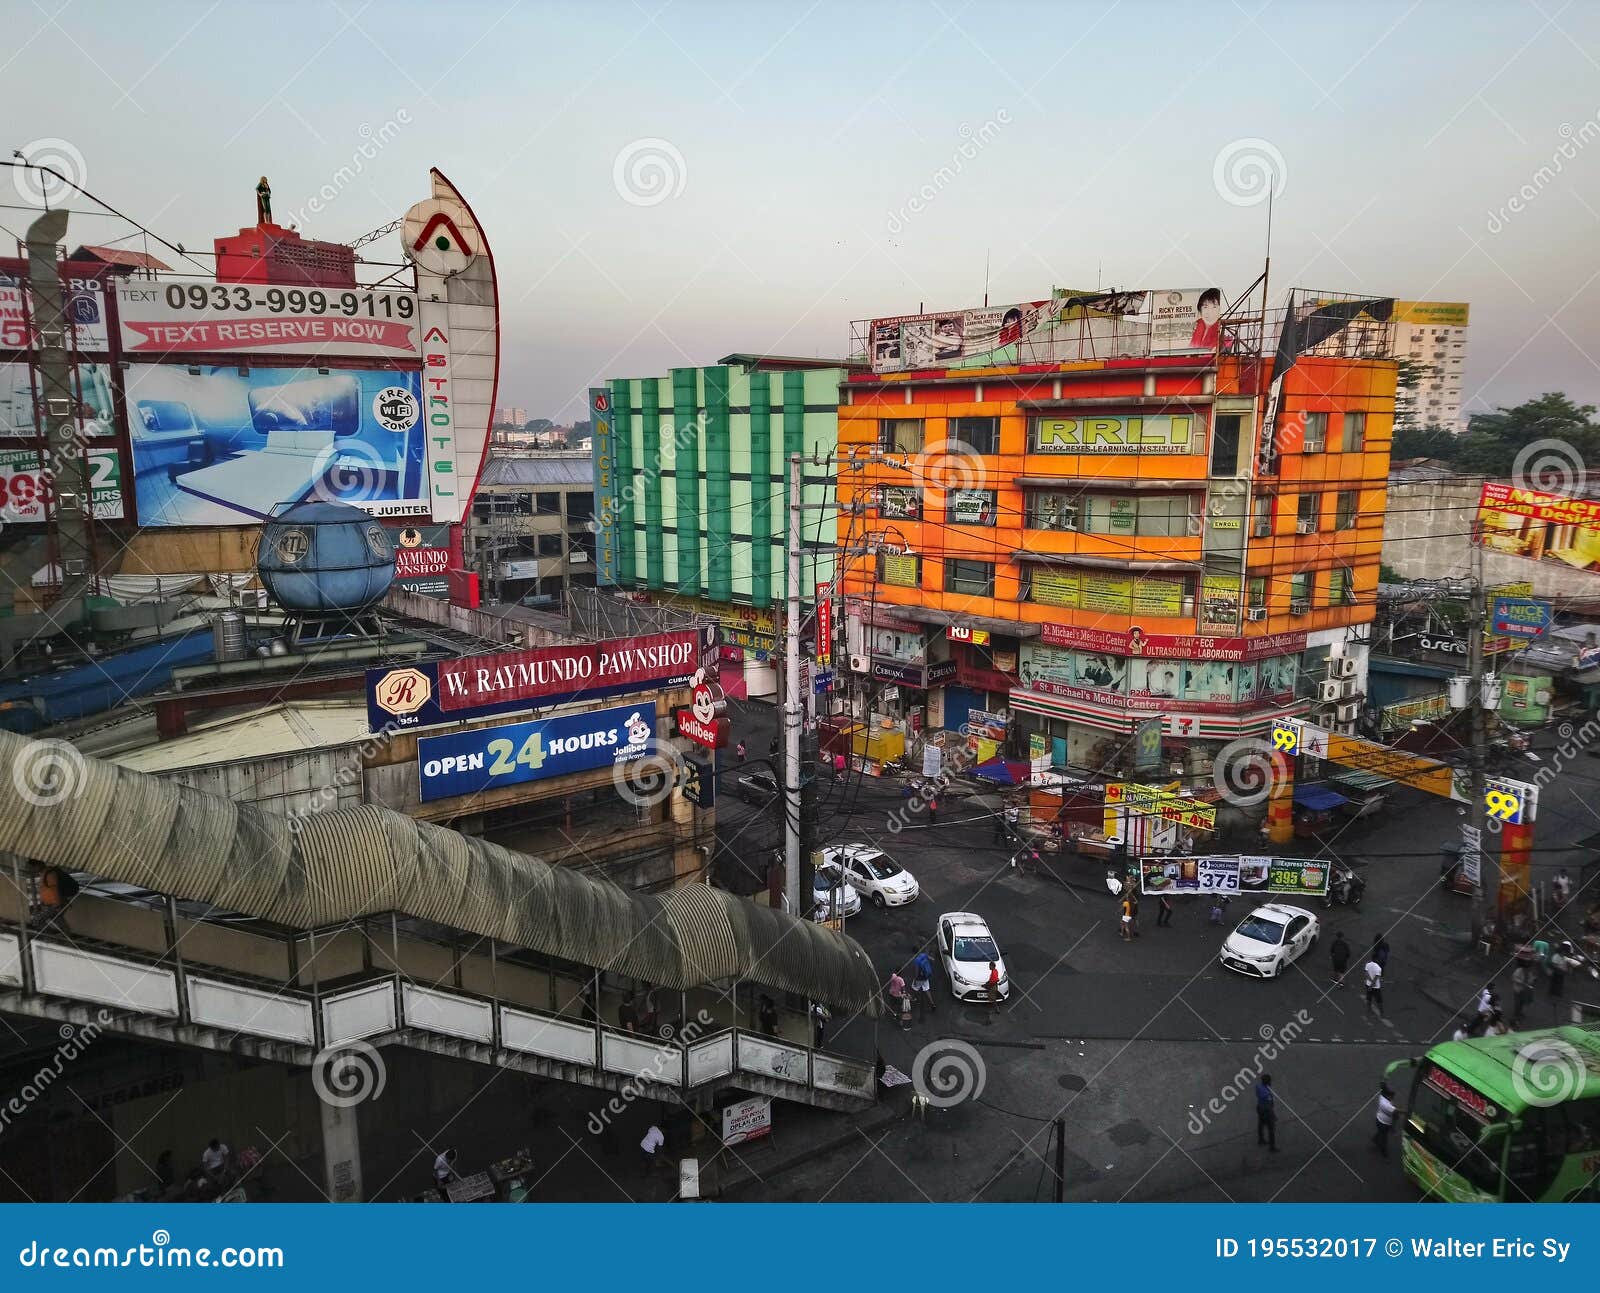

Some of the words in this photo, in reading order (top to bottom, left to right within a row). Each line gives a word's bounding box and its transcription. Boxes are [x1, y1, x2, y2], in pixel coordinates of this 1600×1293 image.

[120, 290, 158, 302] TEXT
[165, 283, 414, 319] 0933-999-9119
[1159, 306, 1174, 314] RICKY
[149, 325, 209, 343] TEXT
[218, 322, 326, 341] RESERVE
[332, 321, 386, 339] NOW
[379, 389, 412, 404] FREE
[383, 419, 412, 431] ZONE
[1041, 418, 1190, 444] RRLI
[1093, 445, 1133, 453] LEARNING
[1138, 445, 1187, 453] INSTITUTE
[378, 505, 428, 516] JUPITER
[1483, 497, 1534, 514] Room
[1510, 605, 1544, 616] NICE
[1106, 634, 1126, 647] Center
[1175, 637, 1194, 647] X-RAY
[1200, 638, 1214, 648] ECG
[1146, 646, 1192, 657] ULTRASOUND
[1198, 649, 1242, 660] LABORATORY
[445, 671, 468, 697] W.
[476, 655, 592, 694] RAYMUNDO
[599, 642, 693, 676] PAWNSHOP
[1039, 683, 1051, 692] St.
[1052, 685, 1091, 701] Michael's
[1093, 694, 1126, 708] Medical
[1127, 699, 1161, 710] Center
[398, 717, 419, 726] 954
[680, 717, 715, 743] Jollibee
[1272, 729, 1297, 752] 99
[424, 752, 484, 778] OPEN
[487, 732, 547, 776] 24
[549, 729, 618, 756] HOURS
[613, 743, 648, 756] Jollibee
[1485, 790, 1519, 820] 99
[730, 1122, 750, 1131] OPLAN
[752, 1115, 766, 1123] SITA
